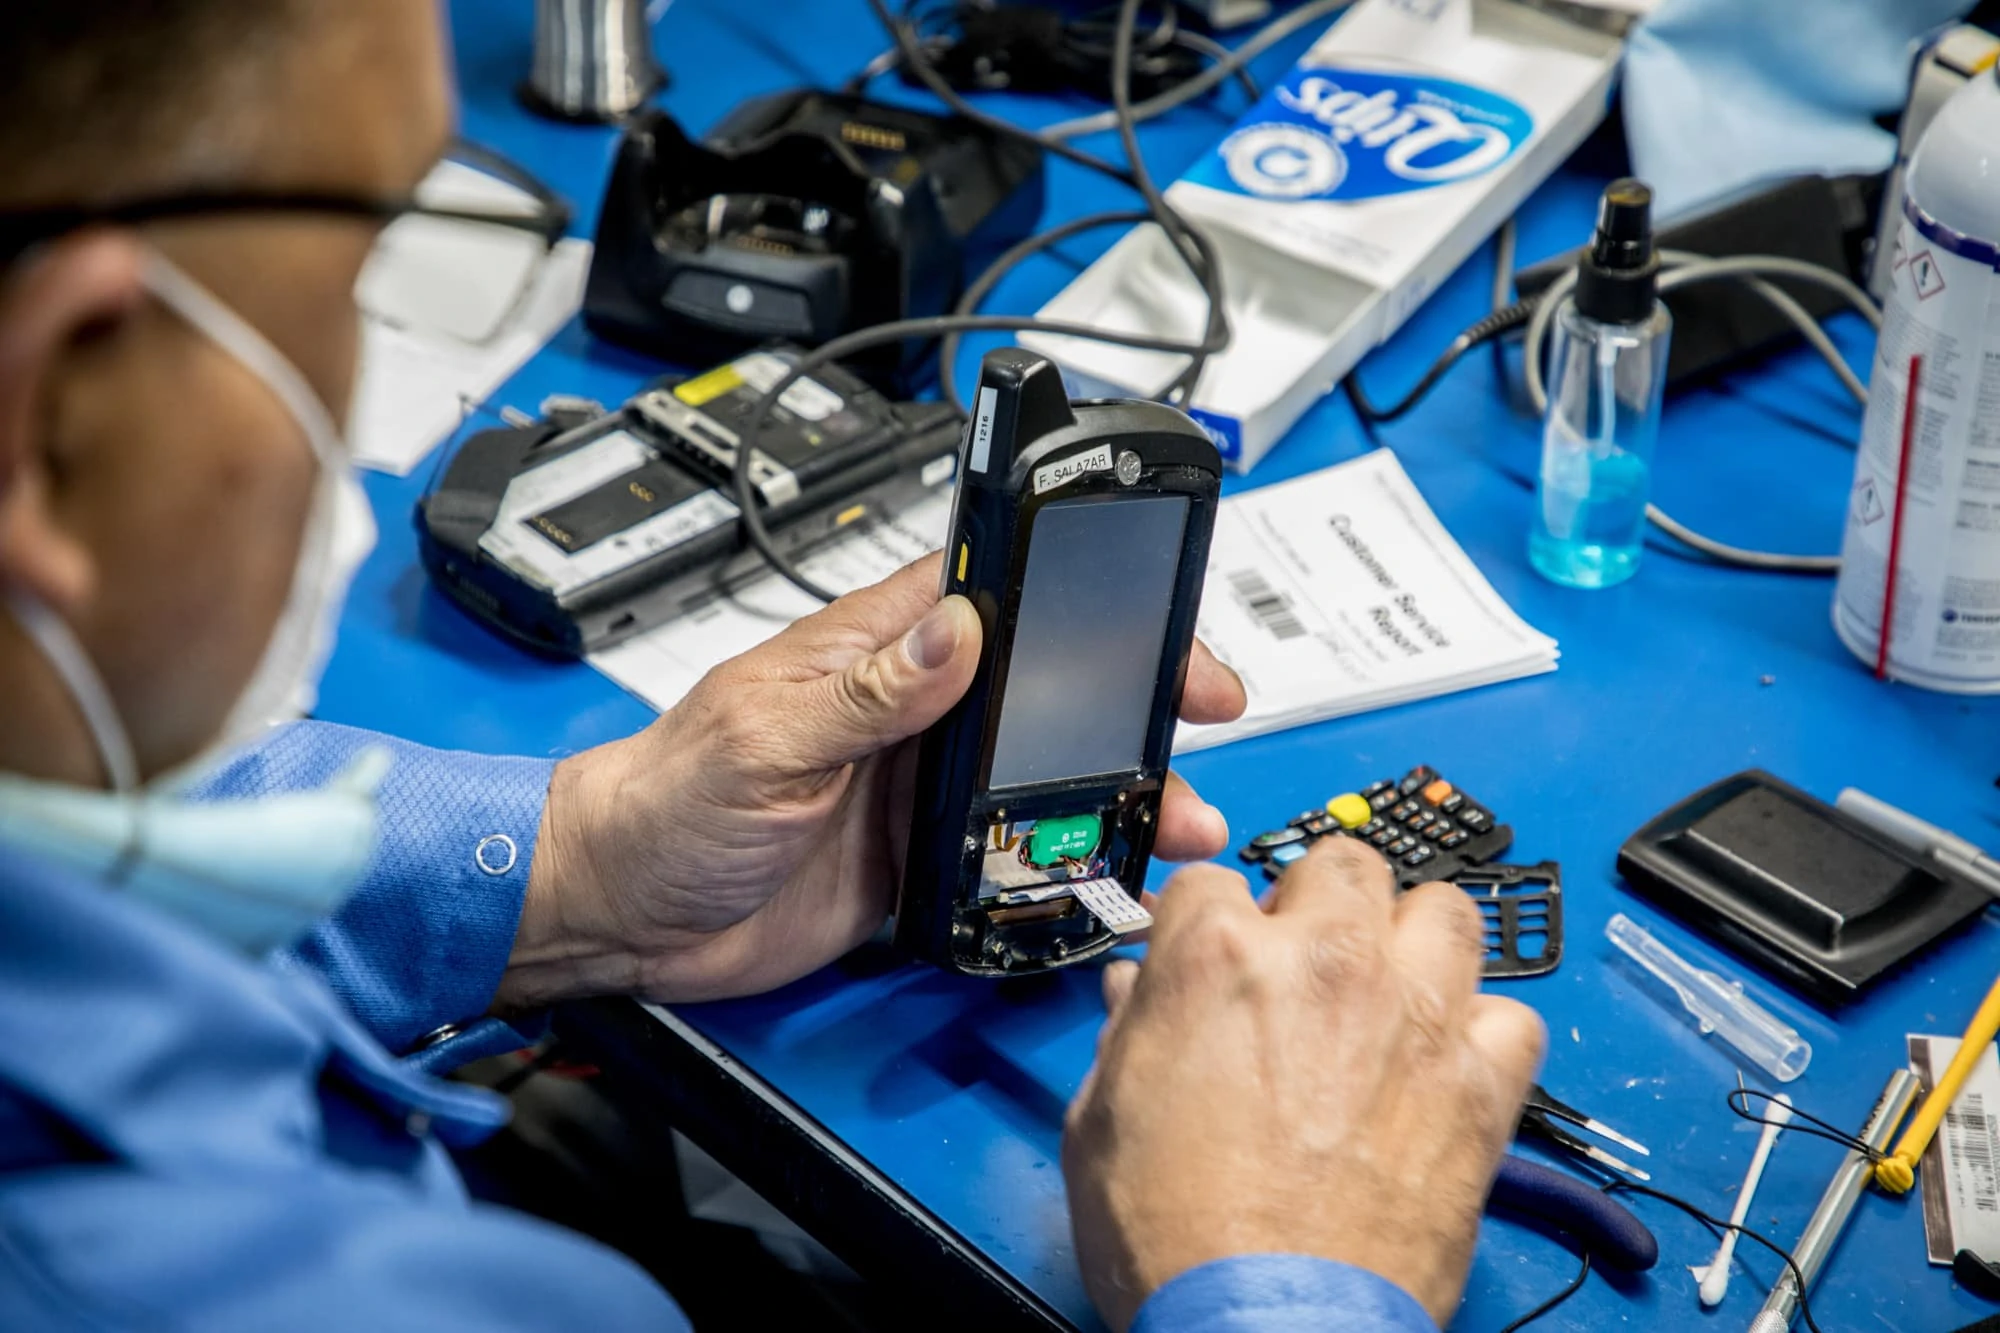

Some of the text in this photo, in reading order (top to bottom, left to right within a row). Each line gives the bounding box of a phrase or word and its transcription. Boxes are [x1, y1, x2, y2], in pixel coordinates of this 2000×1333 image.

[979, 415, 989, 442] 1216
[1039, 454, 1107, 488] F. SALAZAR
[1328, 513, 1398, 590] Customer
[1394, 592, 1451, 648] Service
[1369, 605, 1423, 657] Report
